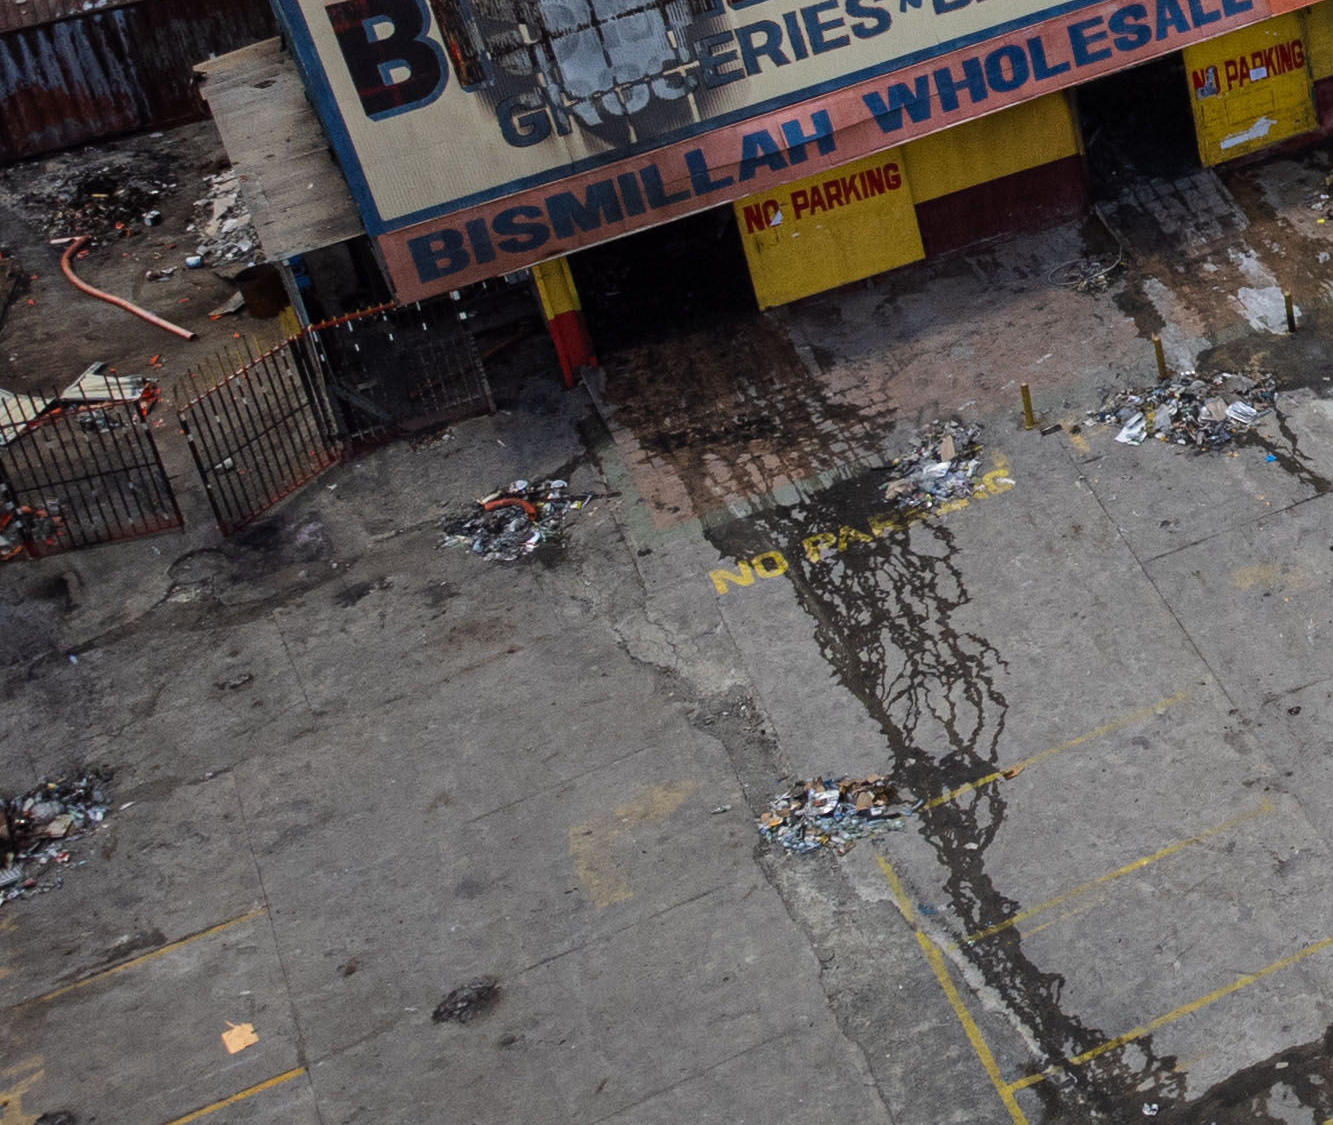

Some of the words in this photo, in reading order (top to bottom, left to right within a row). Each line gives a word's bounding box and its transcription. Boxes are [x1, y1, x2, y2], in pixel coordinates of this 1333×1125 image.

[407, 108, 836, 283] BISMILLAH
[743, 198, 784, 234] NO
[790, 162, 902, 220] PARKING
[709, 550, 789, 595] NO
